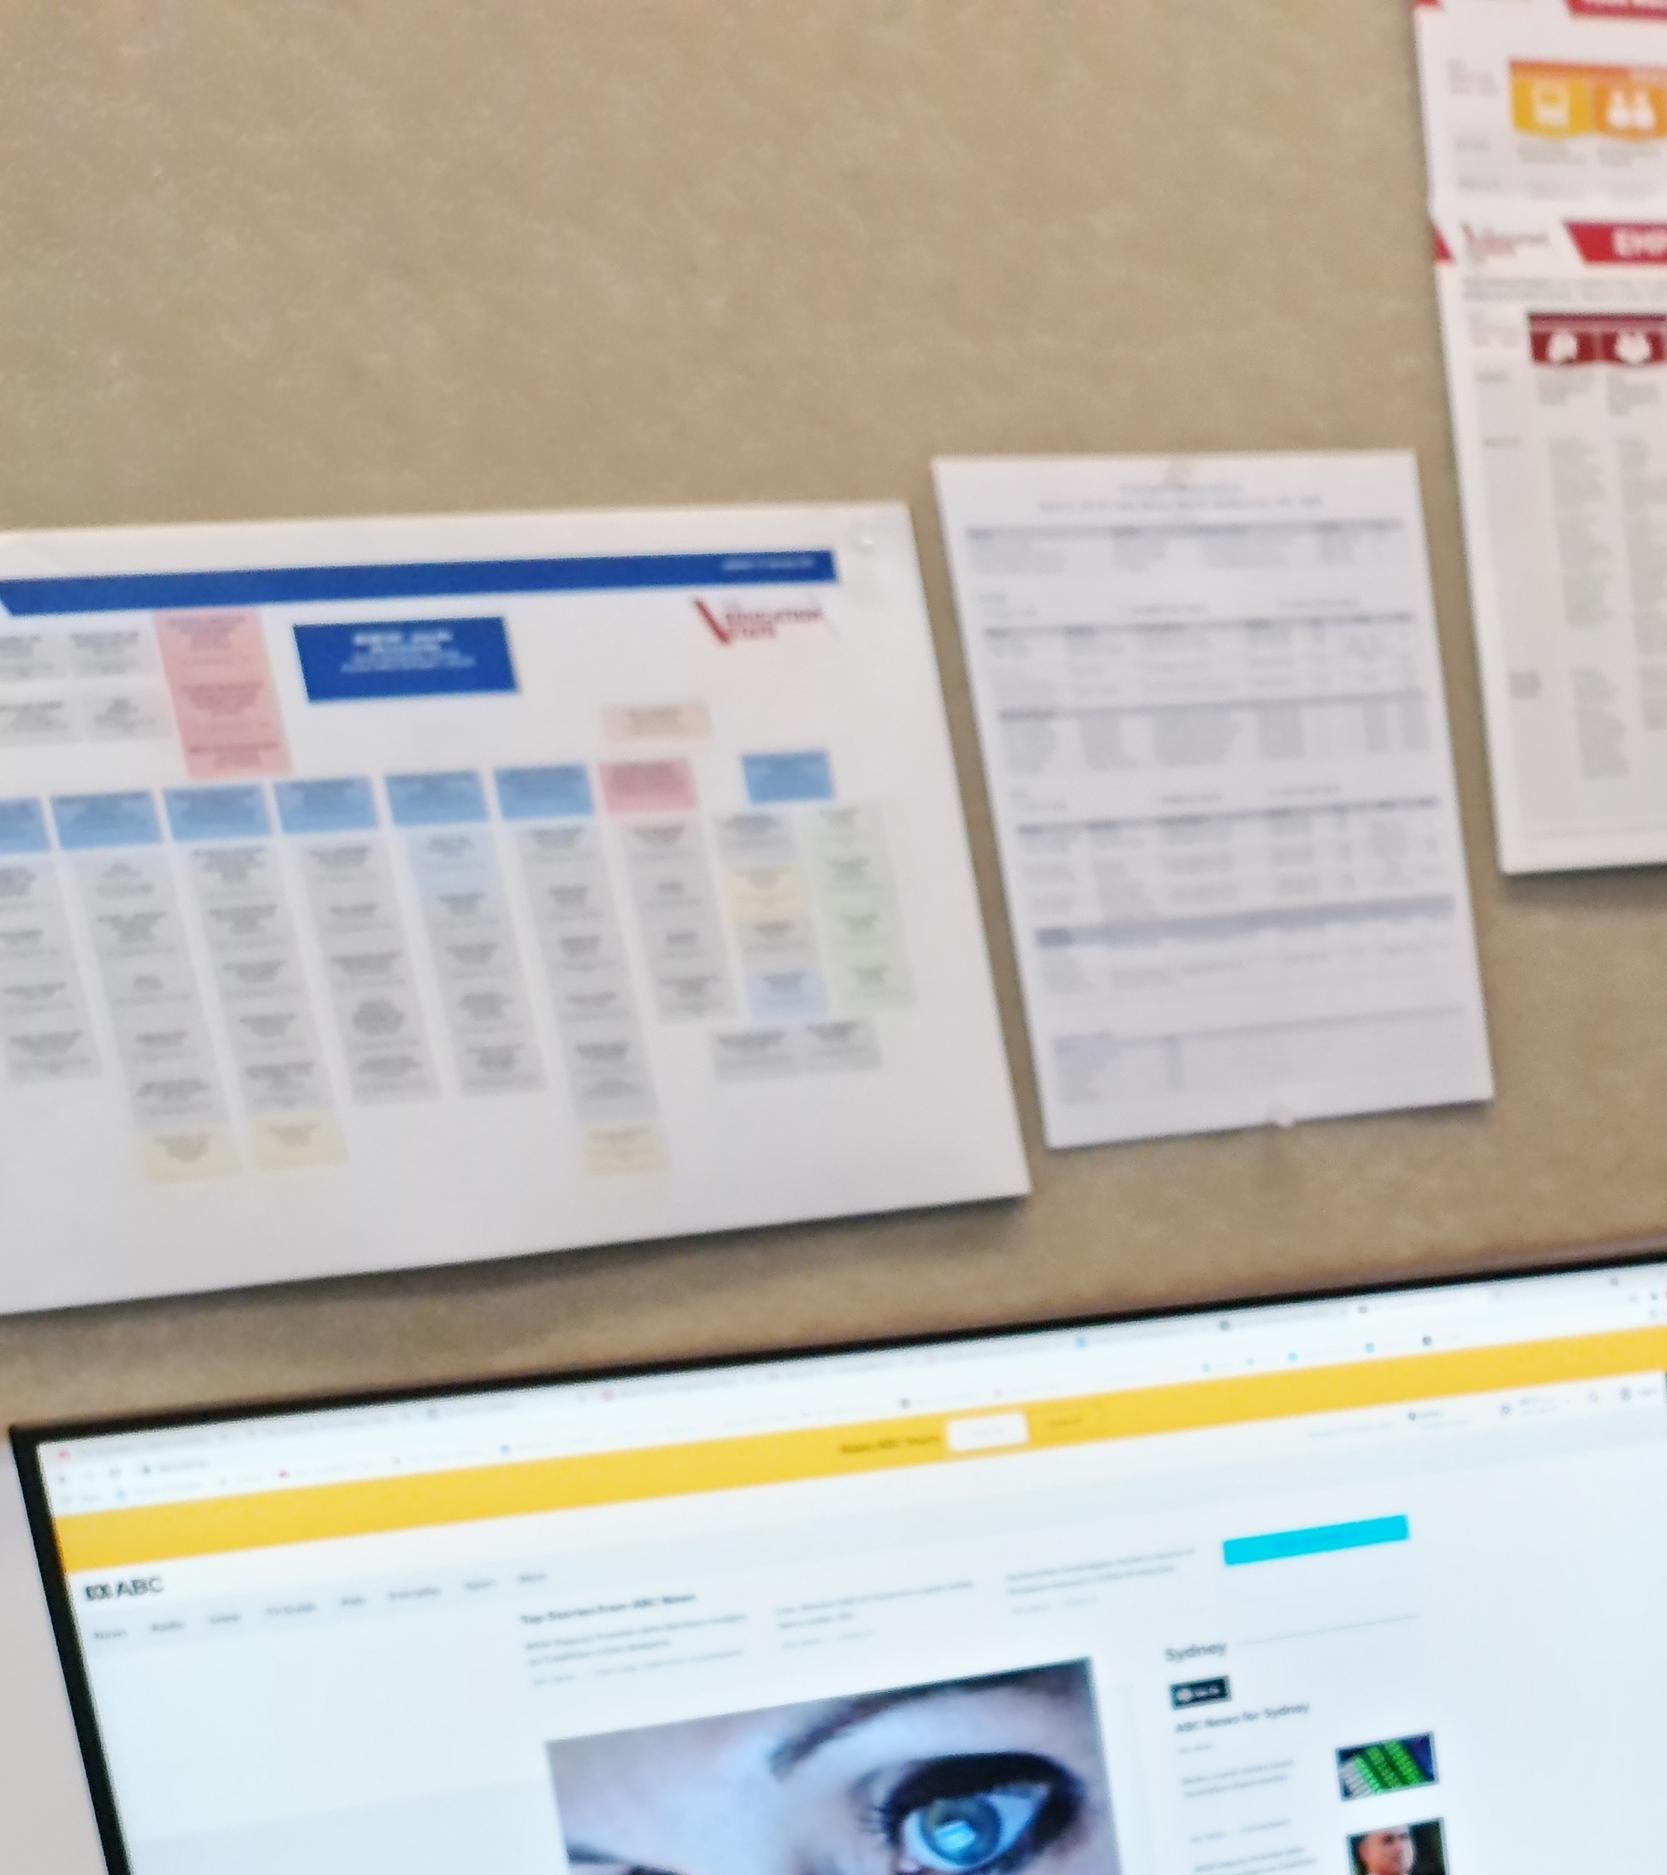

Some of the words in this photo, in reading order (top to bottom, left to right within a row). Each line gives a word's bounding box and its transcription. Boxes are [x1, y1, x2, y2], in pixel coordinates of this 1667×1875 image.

[117, 1576, 164, 1598] ABC
[1165, 1640, 1227, 1665] Sydney
[1264, 1702, 1310, 1721] Sydney
